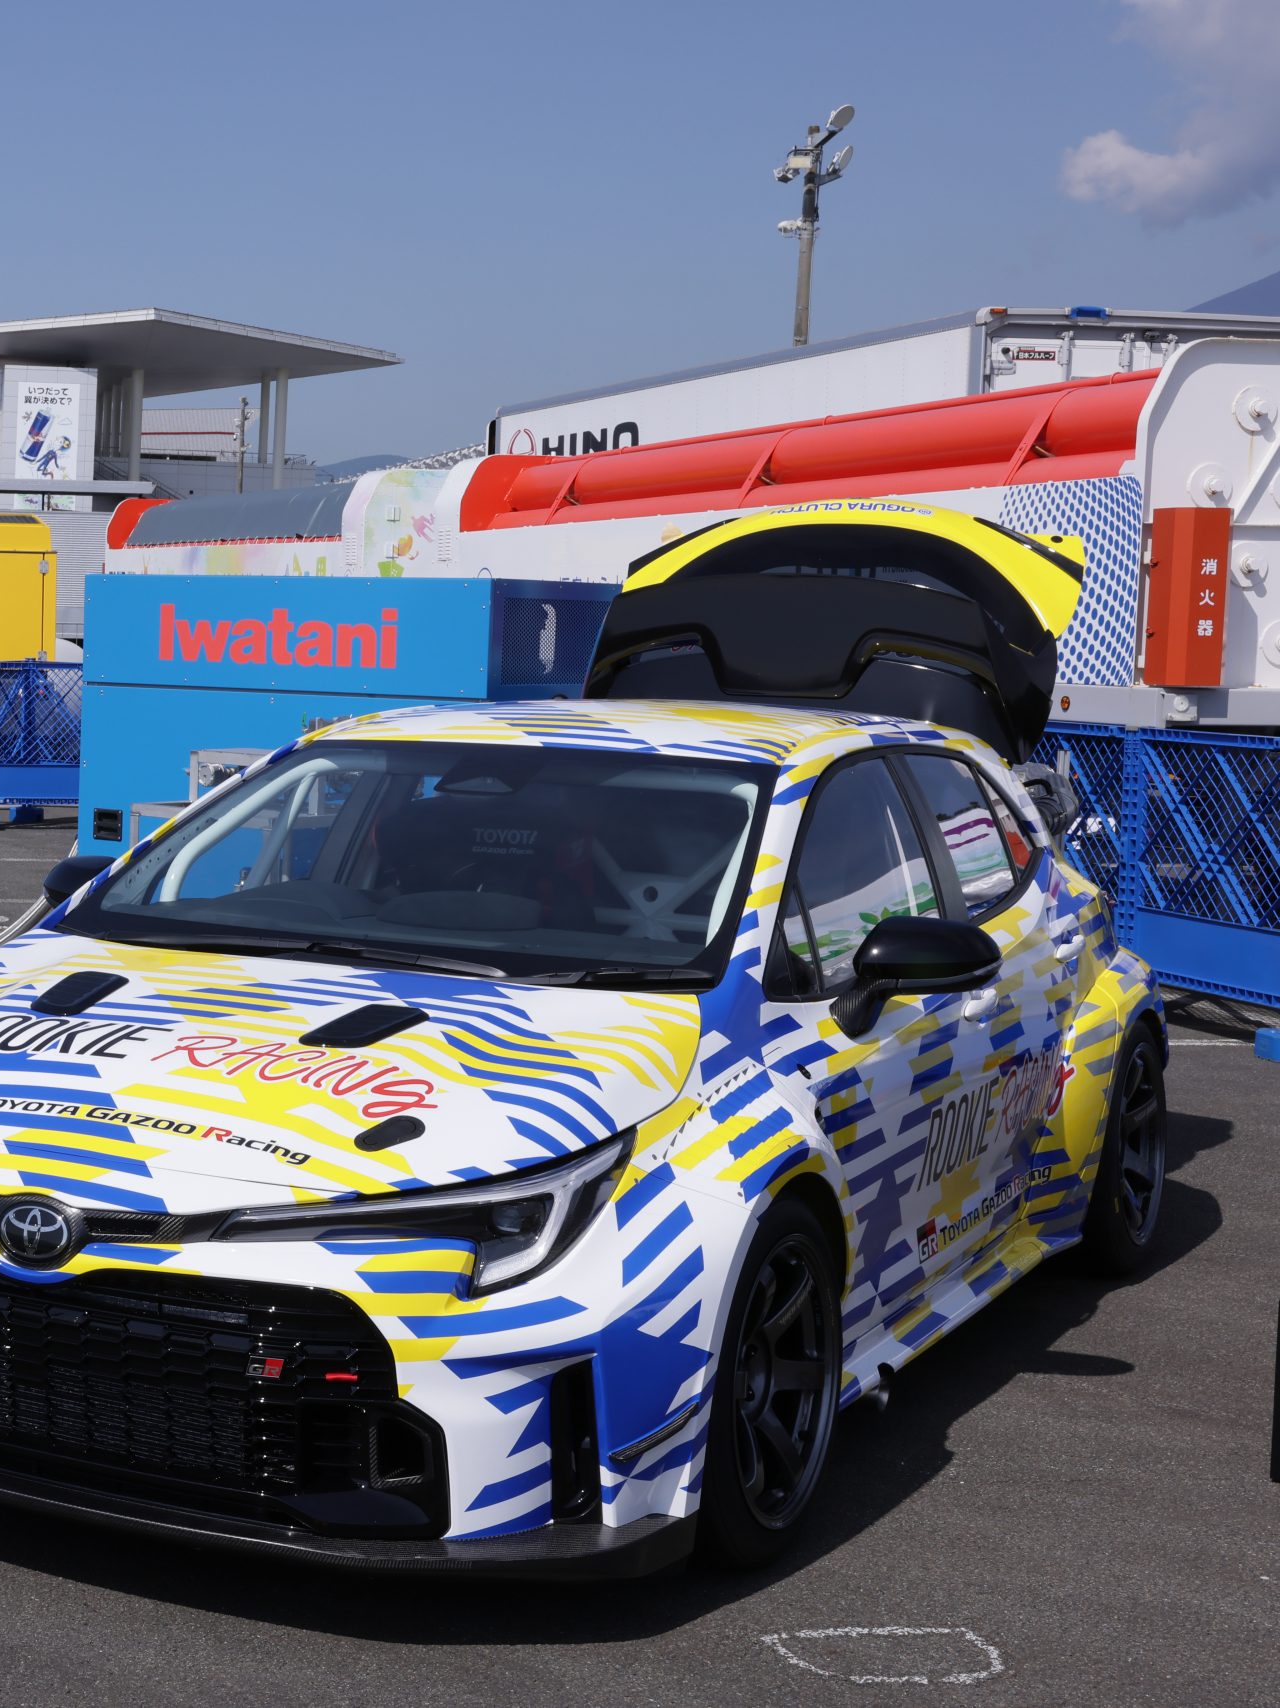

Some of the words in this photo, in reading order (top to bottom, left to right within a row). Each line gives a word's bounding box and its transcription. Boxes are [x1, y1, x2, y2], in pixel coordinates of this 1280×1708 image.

[28, 386, 69, 396] いつだって
[542, 421, 639, 457] HINO
[1197, 558, 1219, 636] 消火器
[158, 603, 398, 669] Iwatani
[150, 1035, 439, 1119] RACING
[85, 1107, 197, 1135] GAZOO
[201, 1126, 312, 1166] Racing
[916, 1076, 1000, 1193] ROOKIE
[919, 1234, 939, 1263] GR
[940, 1207, 981, 1246] TOYOTA
[981, 1183, 1013, 1220] GAZOO
[1013, 1165, 1052, 1197] Racing
[247, 1364, 280, 1376] GR
